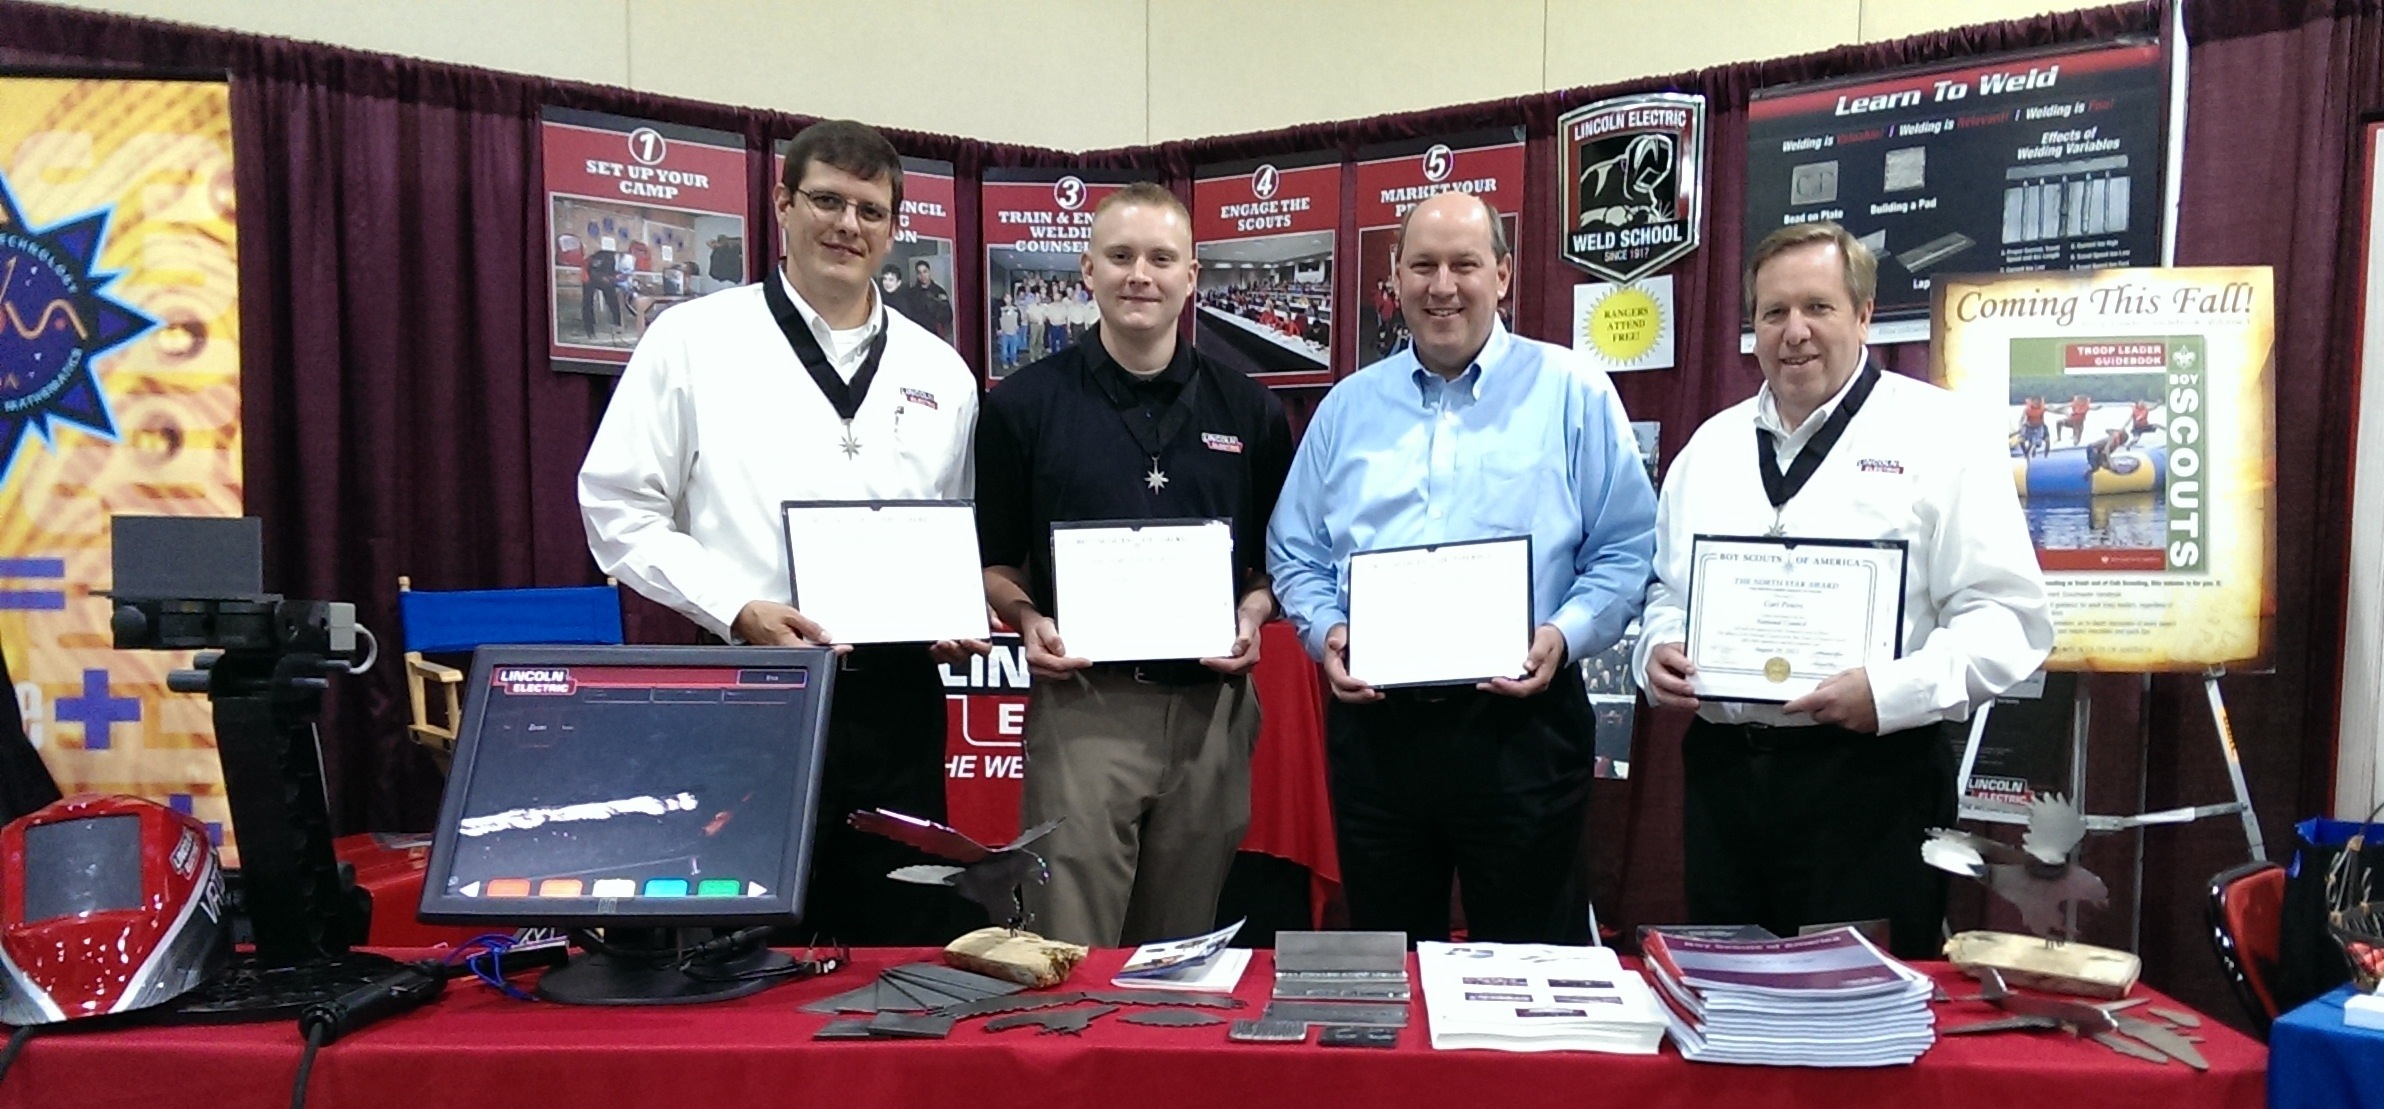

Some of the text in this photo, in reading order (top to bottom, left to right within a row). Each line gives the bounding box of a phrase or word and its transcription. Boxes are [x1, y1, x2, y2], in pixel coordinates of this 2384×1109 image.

[1835, 65, 2059, 116] Learn To Weld
[1574, 110, 1687, 141] LINCOLN ELECTRIC
[1783, 138, 1822, 152] Welding
[1899, 121, 1941, 137] Welding
[1944, 119, 1954, 130] is
[2026, 104, 2071, 120] Welding
[2074, 101, 2085, 114] is
[2041, 126, 2098, 144] Effects of
[639, 133, 655, 160] 1
[2017, 138, 2120, 160] Welding Variables
[1428, 149, 1447, 178] 5
[586, 159, 709, 188] SET UP YOUR
[1257, 168, 1273, 195] 4
[619, 180, 678, 199] CAMP
[1060, 180, 1080, 206] 3
[1381, 178, 1497, 203] MARKET YOUR
[1221, 197, 1310, 219] ENGAGE THE
[1870, 198, 1937, 215] Building a Pad
[998, 211, 1052, 224] TRAIN
[1056, 212, 1069, 224] &
[1237, 214, 1291, 232] SCOUTS
[1783, 209, 1843, 224] Bead on Plate
[1572, 223, 1682, 253] WELD SCHOOL
[1604, 247, 1649, 262] SINCE 1917
[1913, 278, 1930, 290] Lap
[1604, 307, 1648, 319] RANGERS
[1957, 282, 2254, 327] Coming This Fall!
[1607, 320, 1645, 330] ATTEND
[1612, 331, 1640, 342] FREE!
[2077, 345, 2162, 355] TROOP LEADER
[2095, 356, 2162, 365] GUIDEBOOK
[2169, 374, 2199, 385] BOY
[2169, 387, 2199, 567] SCOUTS
[1720, 553, 1860, 567] BOY SCOUTS OF AMERICA
[938, 645, 1030, 688] LIN
[500, 670, 564, 682] LINCOLN
[513, 684, 569, 693] ELECTRIC
[999, 704, 1024, 734] E
[1969, 779, 2023, 793] LINCOLN
